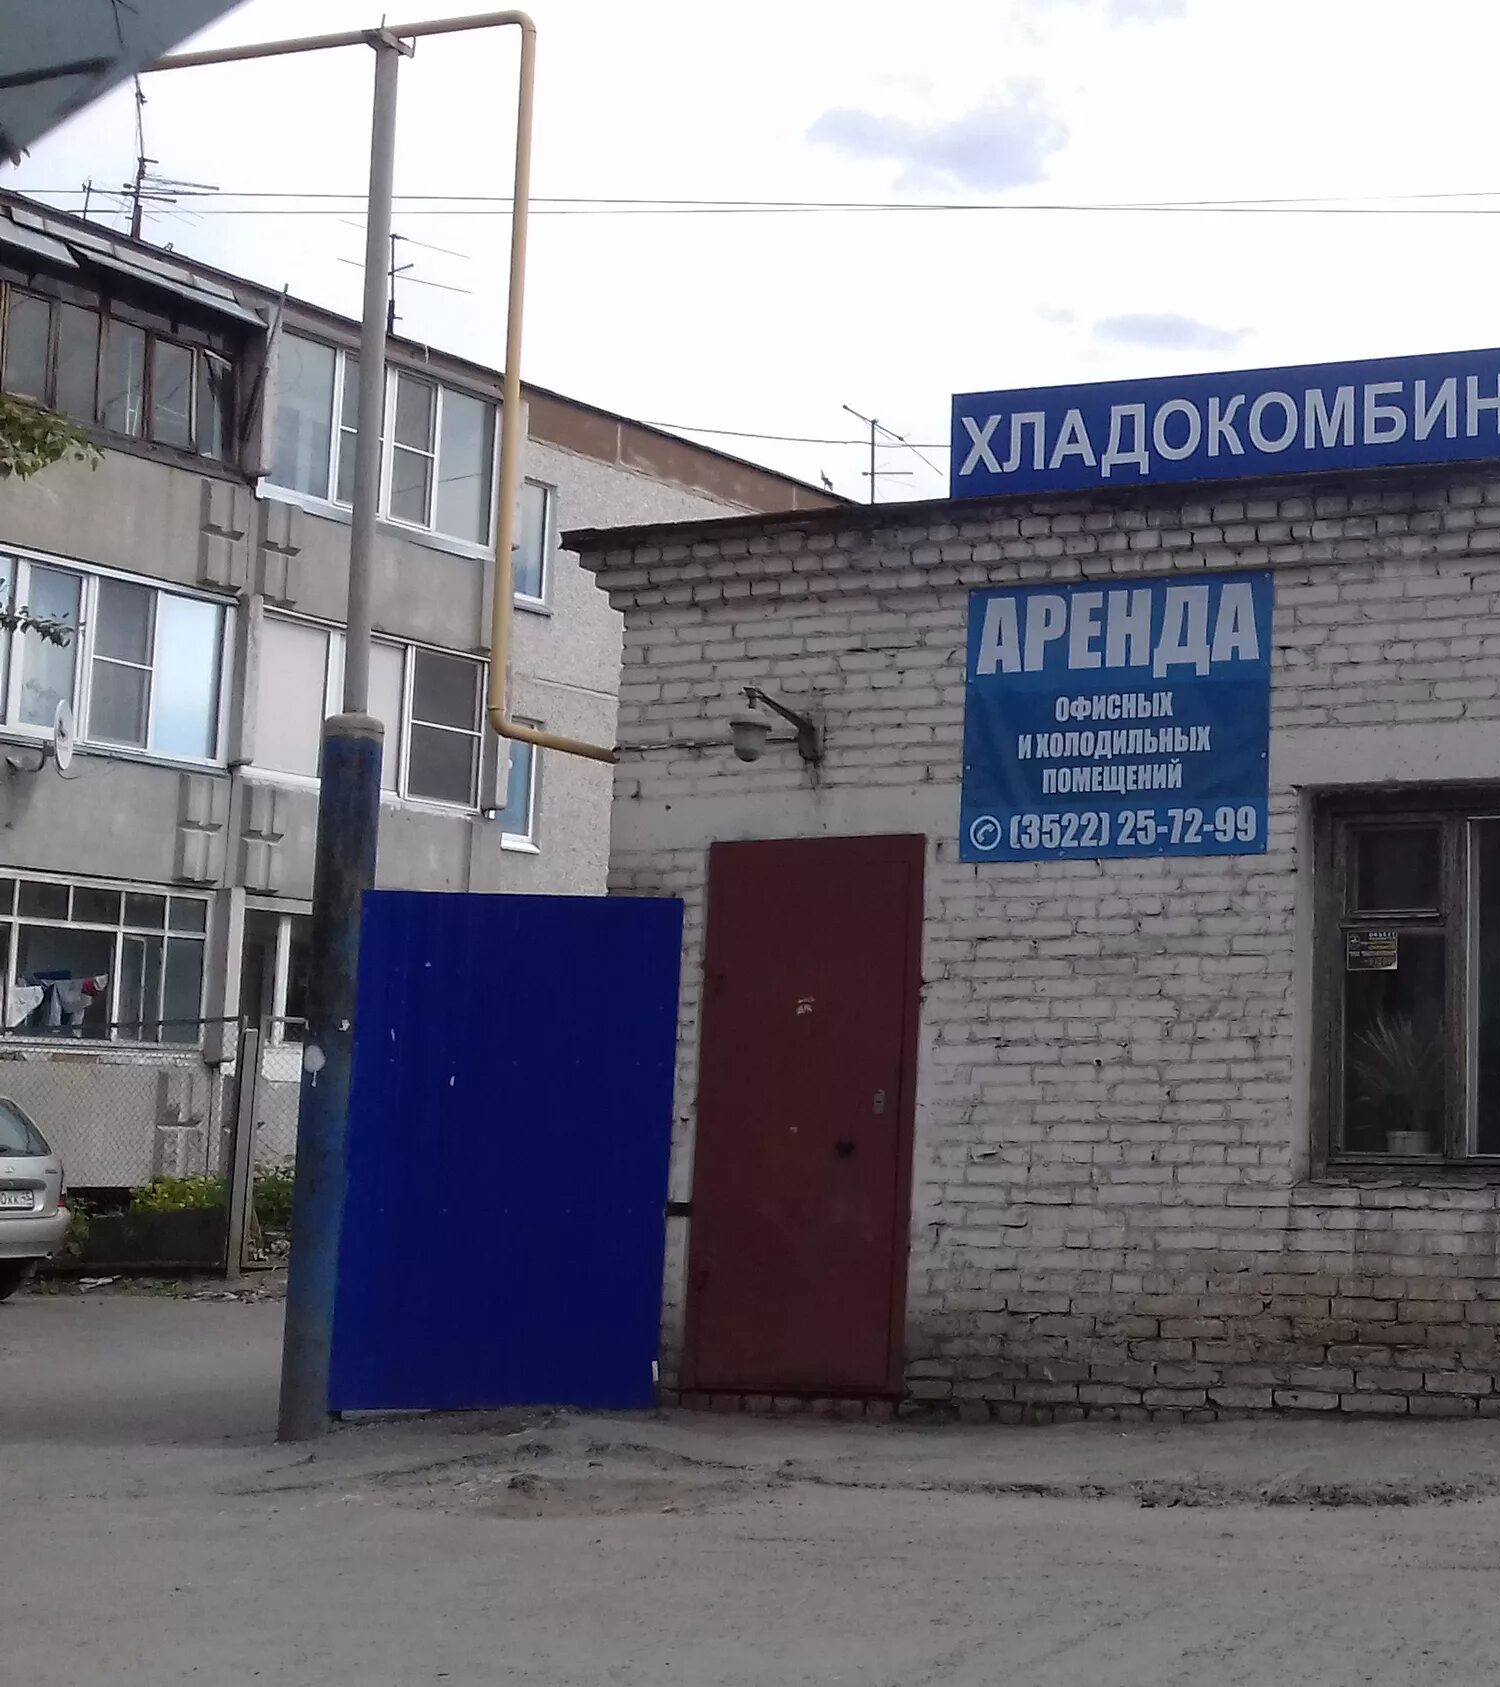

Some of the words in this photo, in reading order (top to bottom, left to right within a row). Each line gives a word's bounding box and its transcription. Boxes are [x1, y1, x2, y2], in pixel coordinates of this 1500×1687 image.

[976, 583, 1260, 678] АРЕНДА
[1055, 691, 1174, 722] ОФИСНЫХ
[1018, 734, 1033, 760] И
[1036, 726, 1211, 760] ХОЛОДИЛЬНЫХ
[1042, 759, 1183, 794] ПОМЕЩЕНИЙ
[1009, 812, 1110, 849] (3522)
[1117, 806, 1257, 846] 25-72-99
